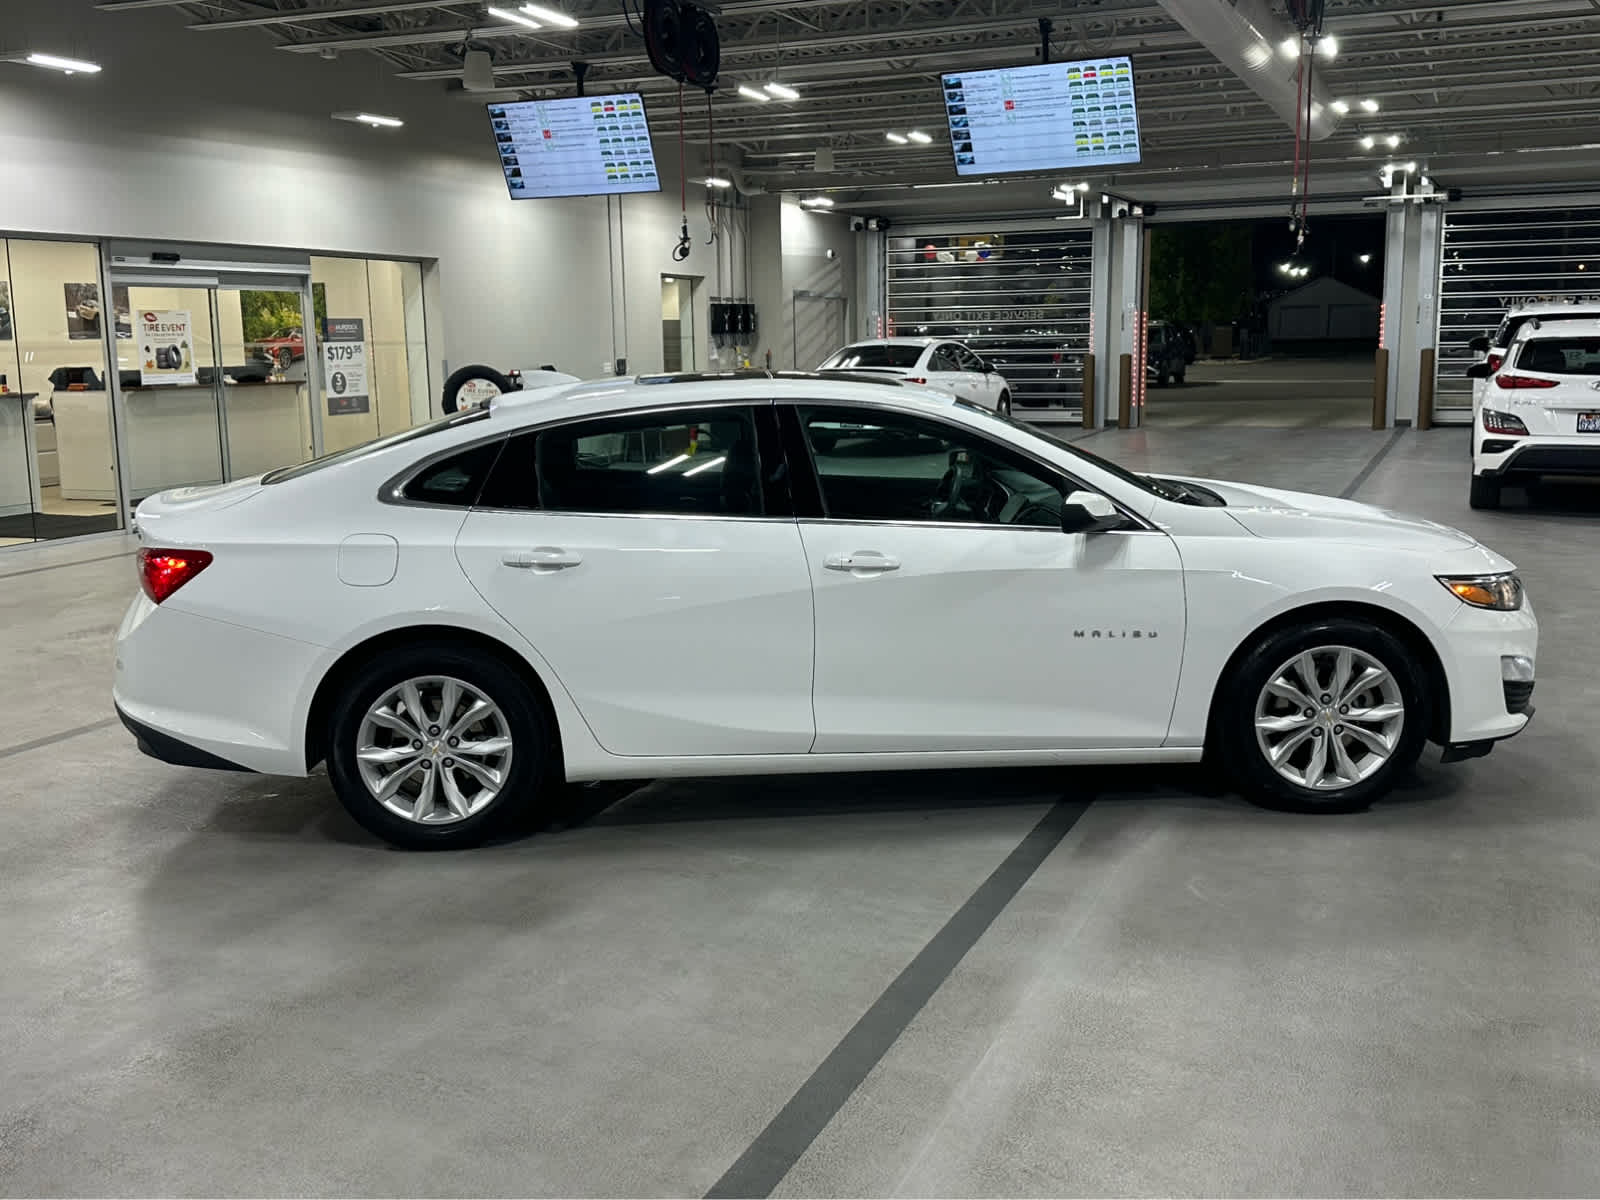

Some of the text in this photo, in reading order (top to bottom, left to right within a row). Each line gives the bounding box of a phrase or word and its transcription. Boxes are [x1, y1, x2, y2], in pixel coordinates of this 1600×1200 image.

[143, 323, 186, 332] TIRE EVENT
[335, 374, 343, 386] 3
[1073, 629, 1158, 639] MALIBU
